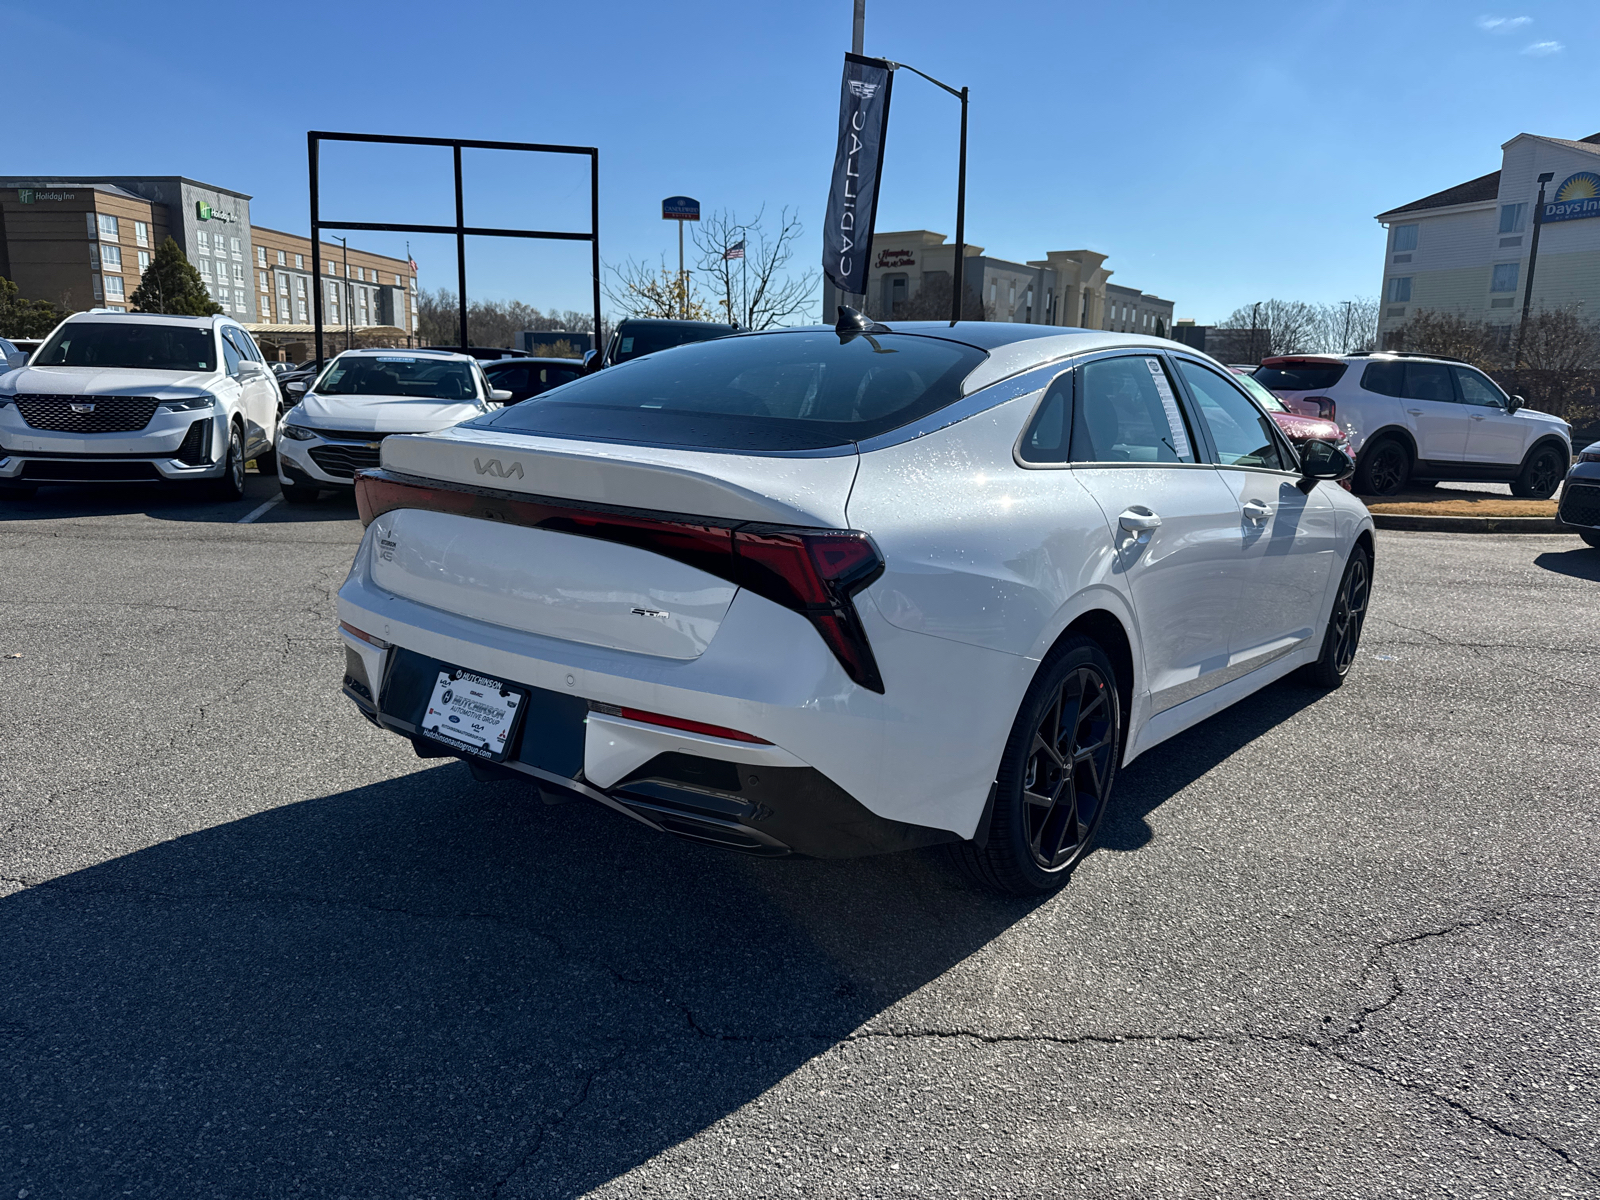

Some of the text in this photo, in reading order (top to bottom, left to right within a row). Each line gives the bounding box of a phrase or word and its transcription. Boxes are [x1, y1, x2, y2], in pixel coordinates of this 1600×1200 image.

[35, 191, 75, 201] Holiday Inn
[1546, 203, 1581, 215] Days
[473, 457, 525, 480] KIA
[462, 672, 503, 690] HUTCHINSON
[449, 705, 482, 721] AUTOMOTIVE
[481, 715, 500, 726] GROUP
[451, 695, 507, 720] HUTCHINSON
